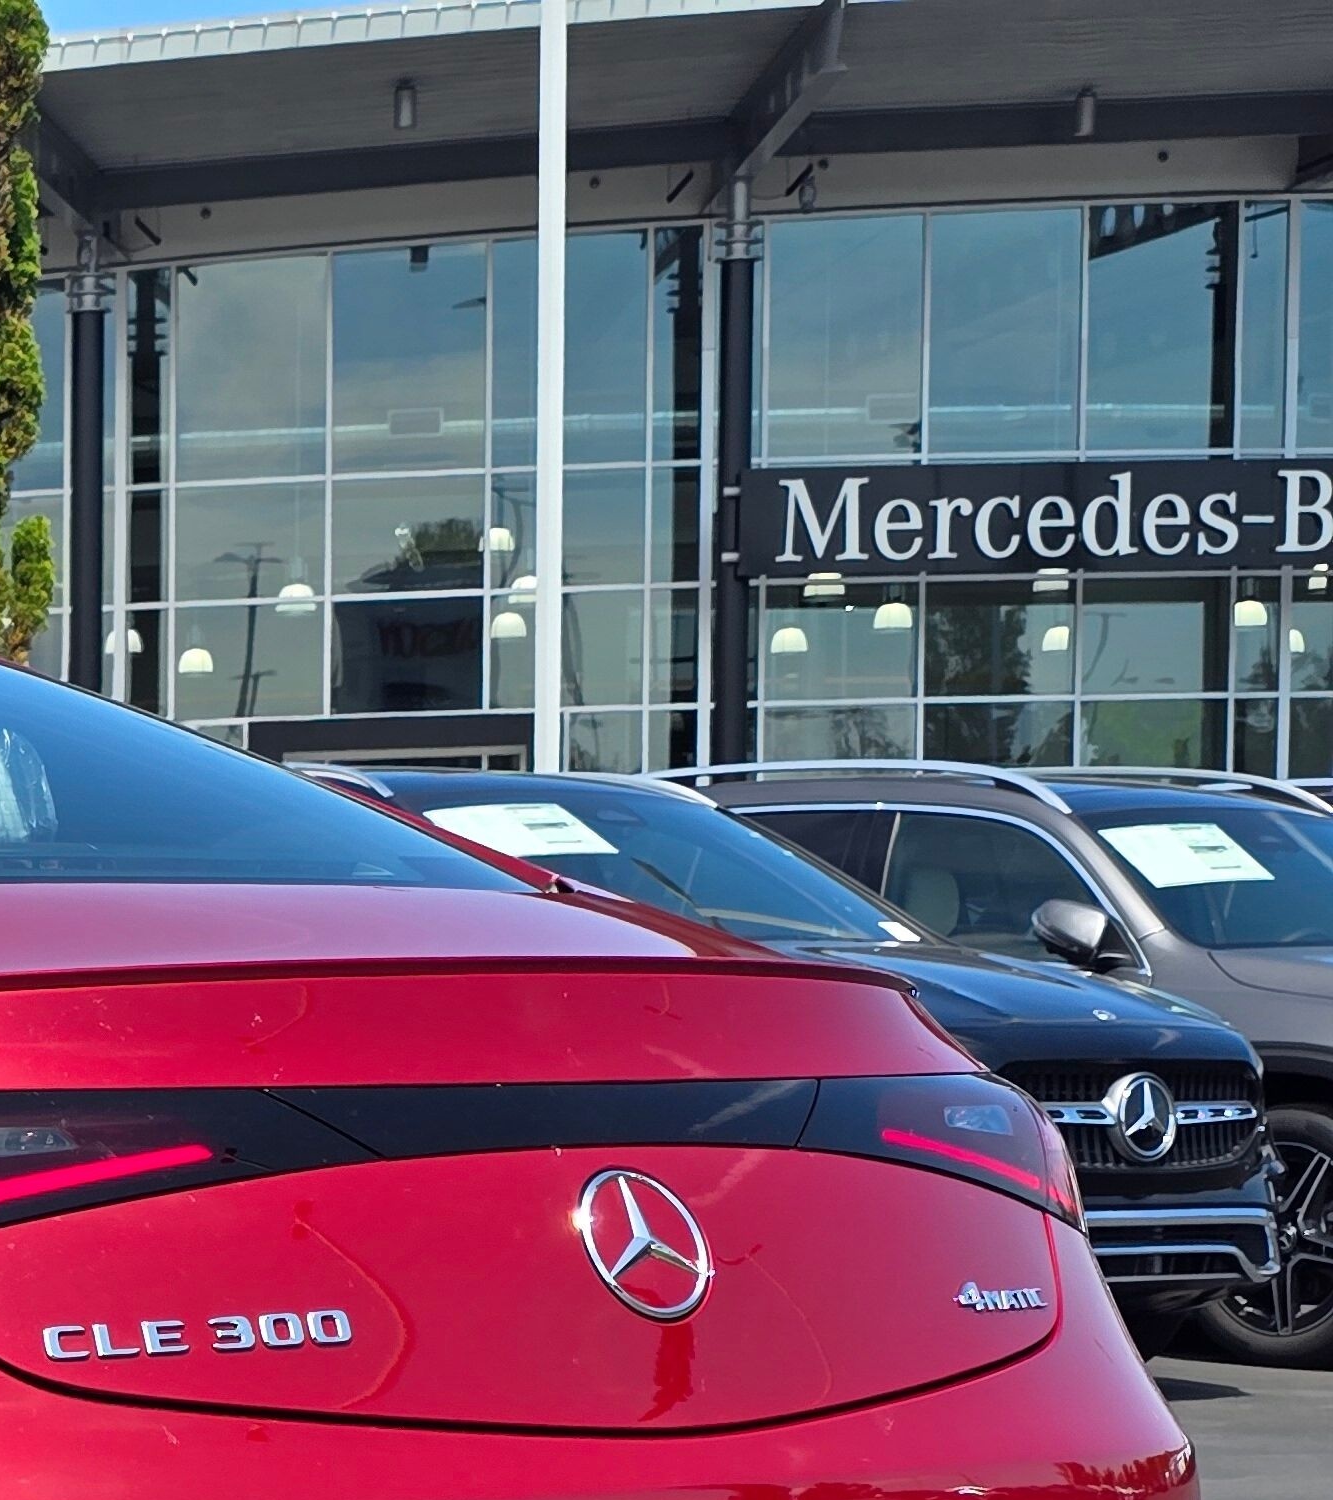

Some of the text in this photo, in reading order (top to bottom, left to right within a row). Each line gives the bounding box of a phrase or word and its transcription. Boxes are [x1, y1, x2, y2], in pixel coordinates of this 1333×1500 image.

[775, 469, 1333, 562] Mercedes-B
[953, 1281, 1049, 1312] 4MATIC
[42, 1309, 353, 1360] CLE 300
